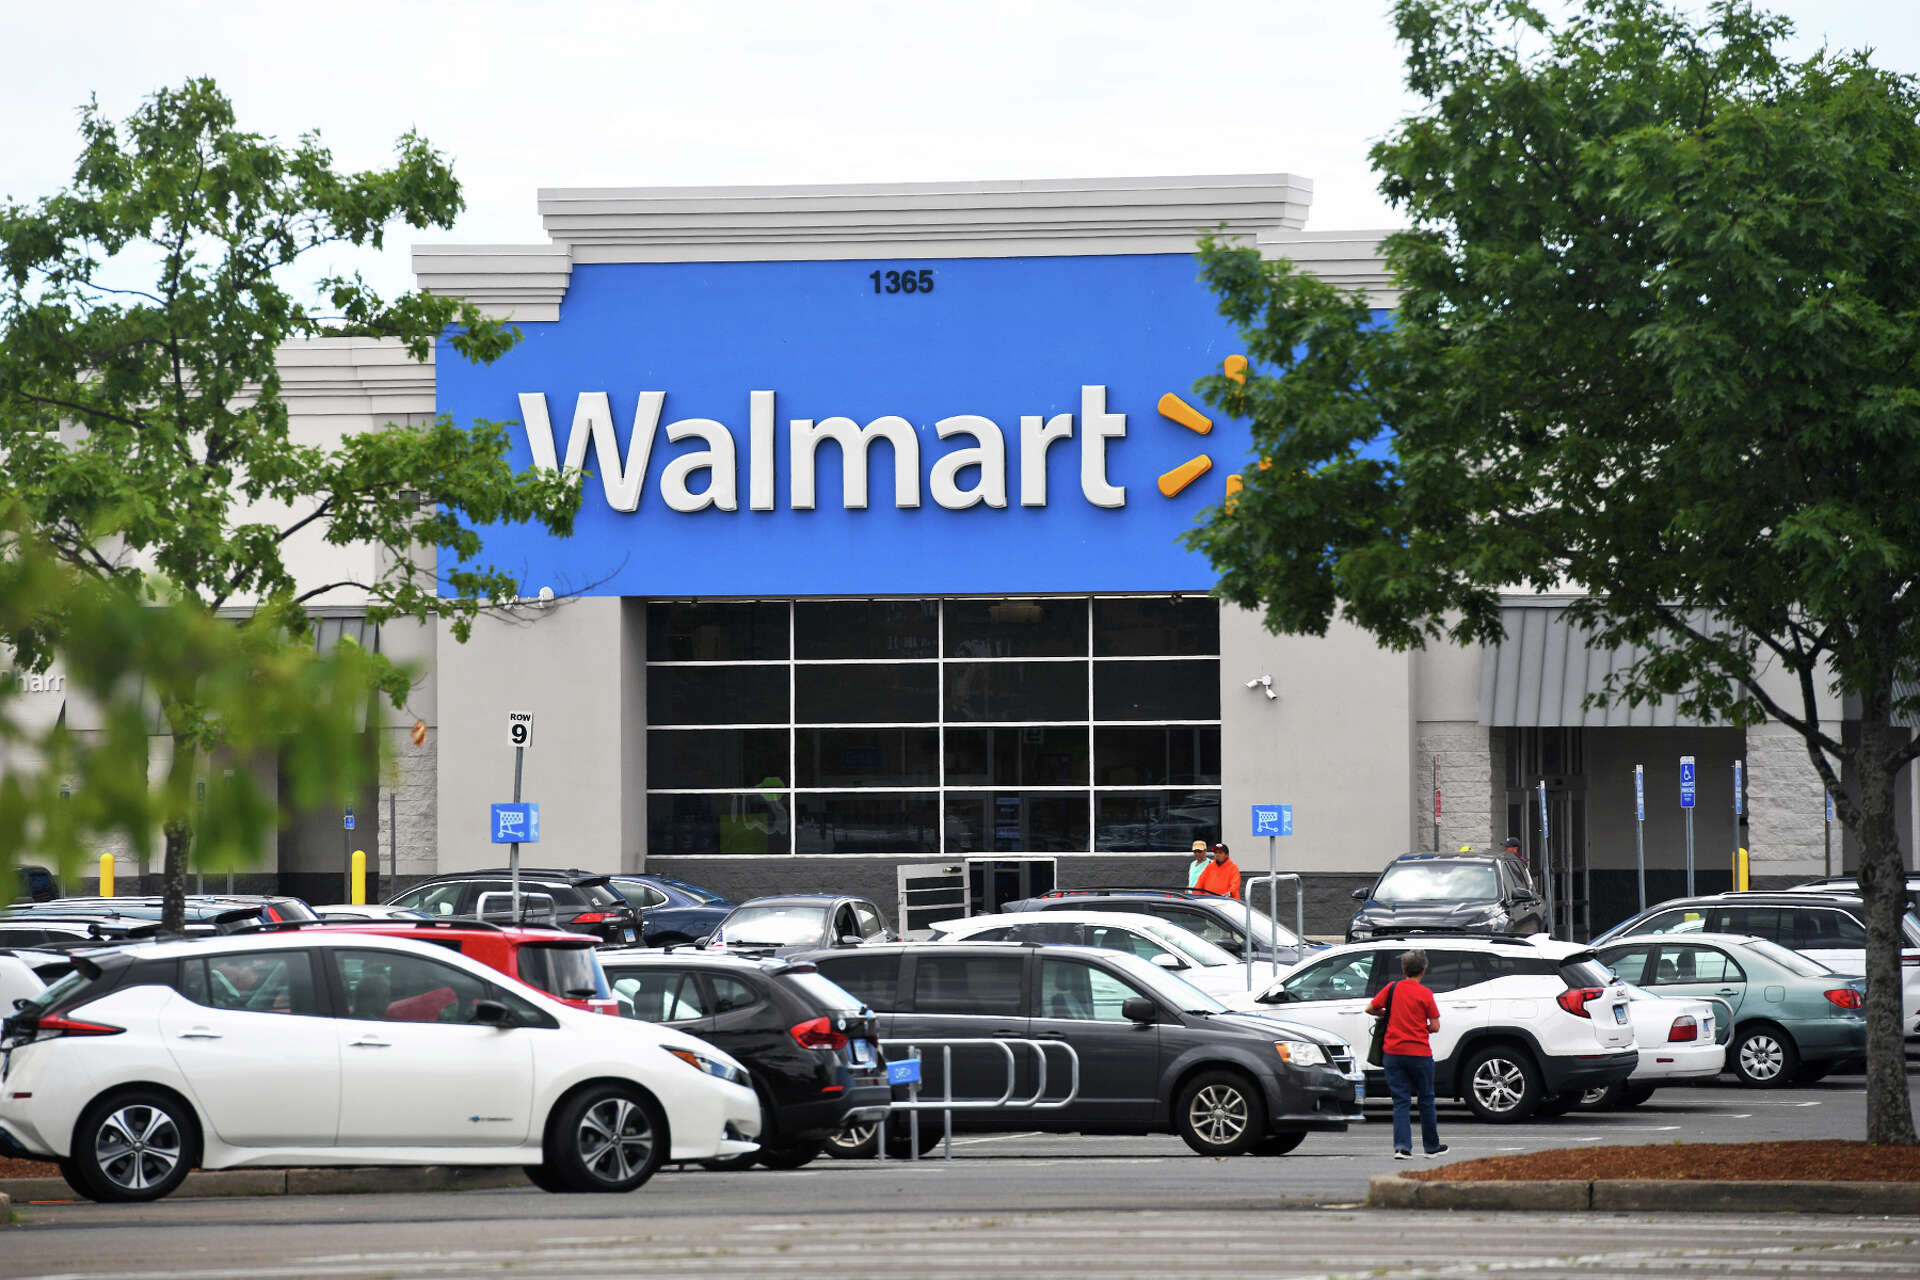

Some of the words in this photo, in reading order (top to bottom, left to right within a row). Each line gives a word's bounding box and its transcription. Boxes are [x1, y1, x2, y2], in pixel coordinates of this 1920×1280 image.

[869, 269, 934, 294] 1365
[518, 384, 1127, 513] Walmart
[510, 713, 531, 721] ROW
[511, 723, 527, 744] 9
